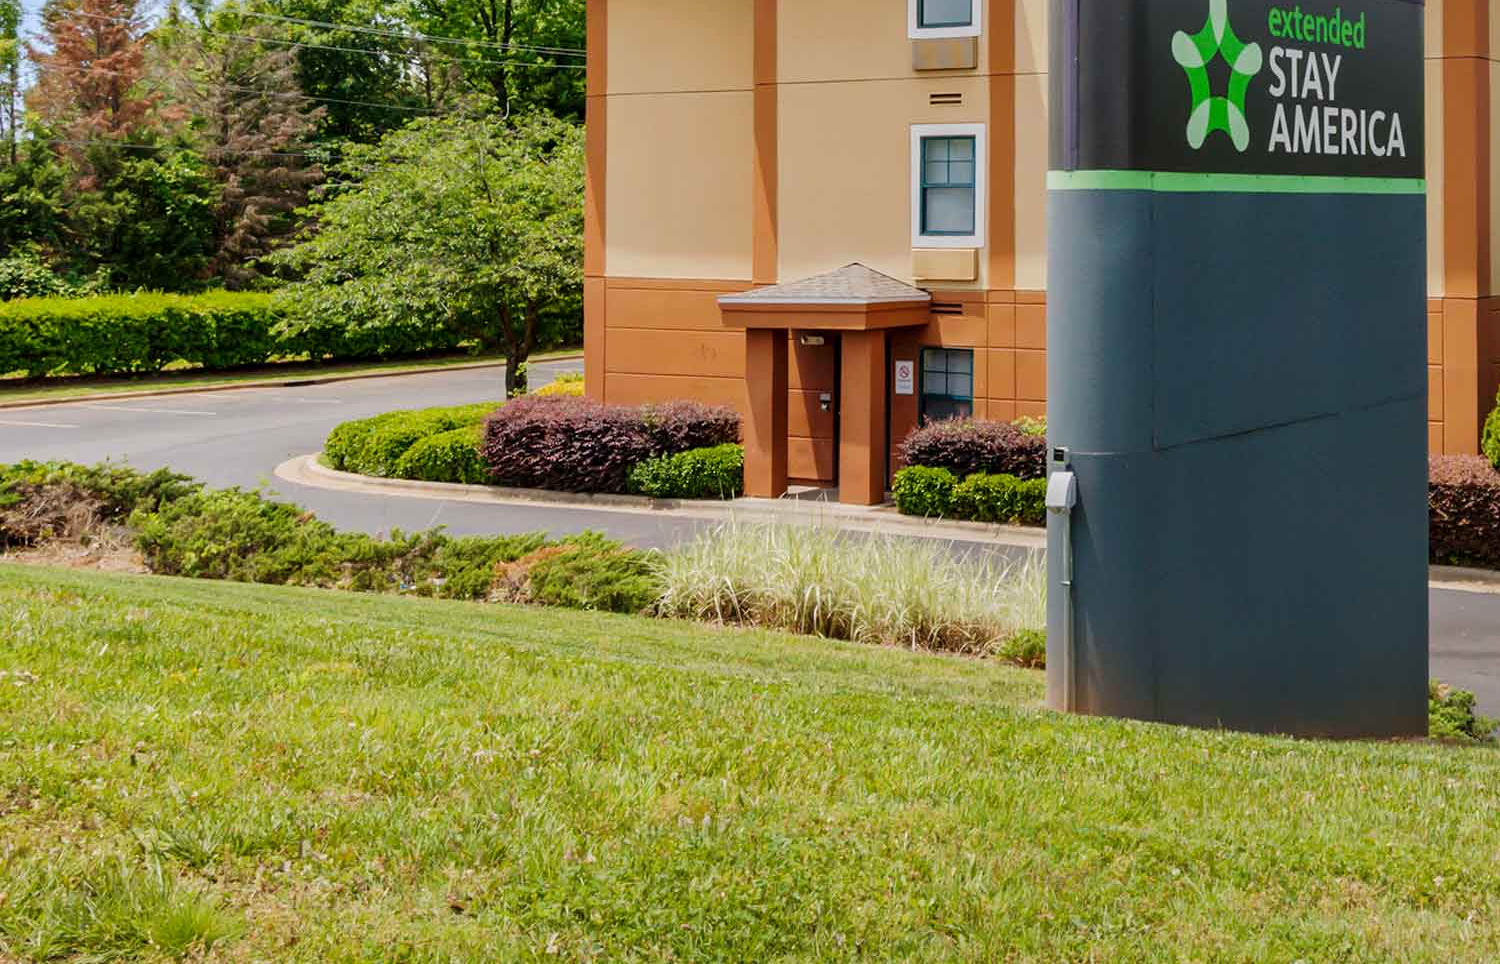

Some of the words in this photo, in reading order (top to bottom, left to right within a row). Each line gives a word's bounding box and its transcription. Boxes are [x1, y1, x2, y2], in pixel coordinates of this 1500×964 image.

[1268, 5, 1366, 49] extended
[1268, 45, 1342, 101] STAY
[1267, 102, 1406, 158] AMERICA
